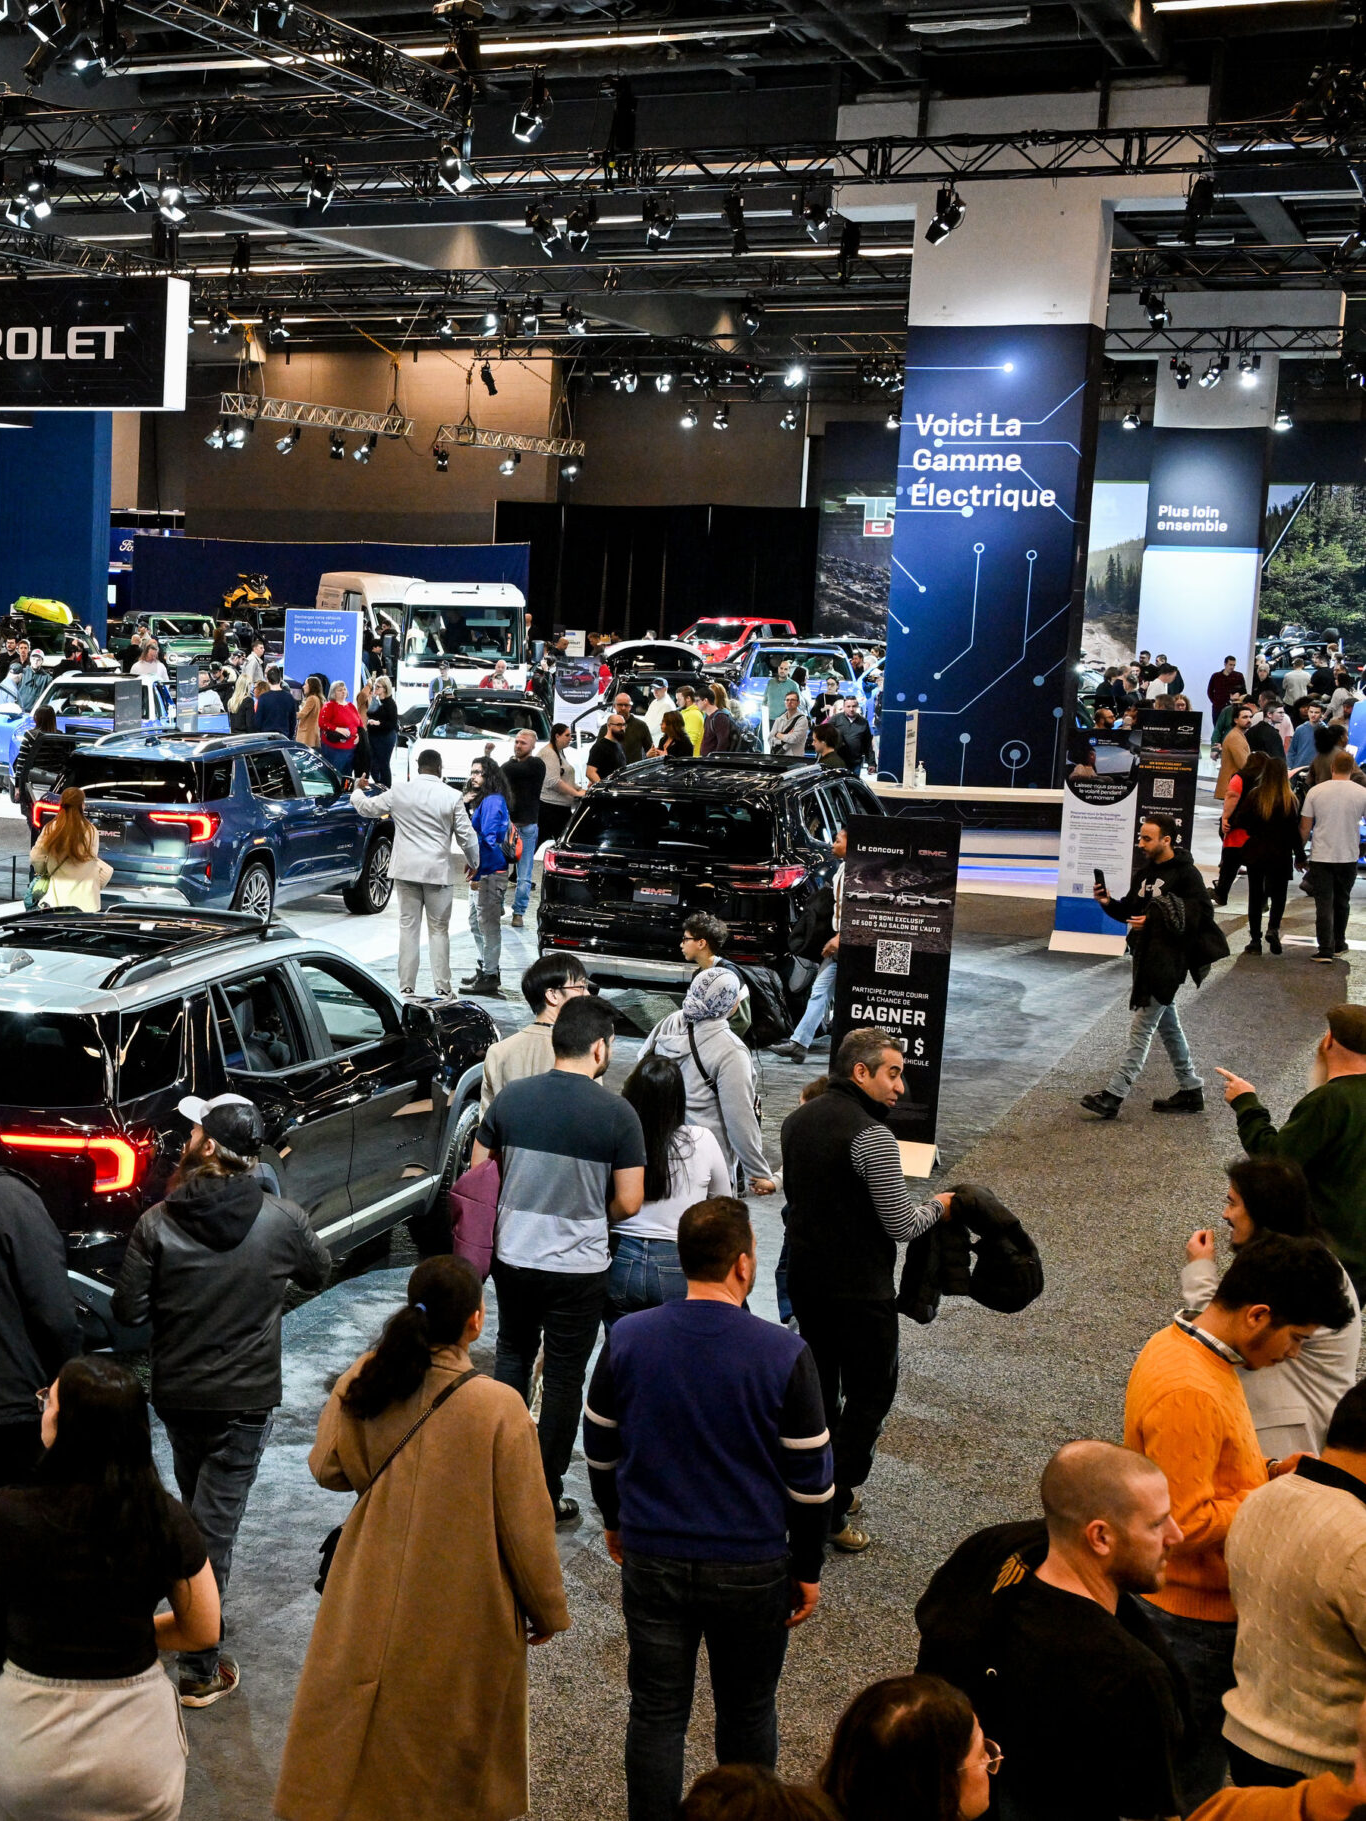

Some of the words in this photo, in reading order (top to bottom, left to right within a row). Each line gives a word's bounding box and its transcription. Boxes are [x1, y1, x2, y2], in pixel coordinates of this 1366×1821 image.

[916, 412, 982, 436] Voici
[991, 413, 1021, 436] La
[913, 448, 1021, 472] Gamme
[911, 477, 1056, 512] Électrique
[1158, 504, 1190, 518] Plus
[1192, 505, 1220, 518] loin
[1157, 519, 1228, 532] ensemble
[857, 844, 867, 852] Le
[868, 846, 905, 855] concours
[917, 849, 948, 858] GMC
[640, 887, 673, 897] GMC
[895, 916, 925, 924] EXCLUSIF
[919, 925, 941, 933] L'AUTO
[852, 986, 887, 995] PARTICIPEZ
[876, 996, 901, 1005] CHANCE
[851, 1003, 926, 1027] GAGNER
[914, 1037, 925, 1057] $
[903, 1058, 930, 1067] ÉHICULE
